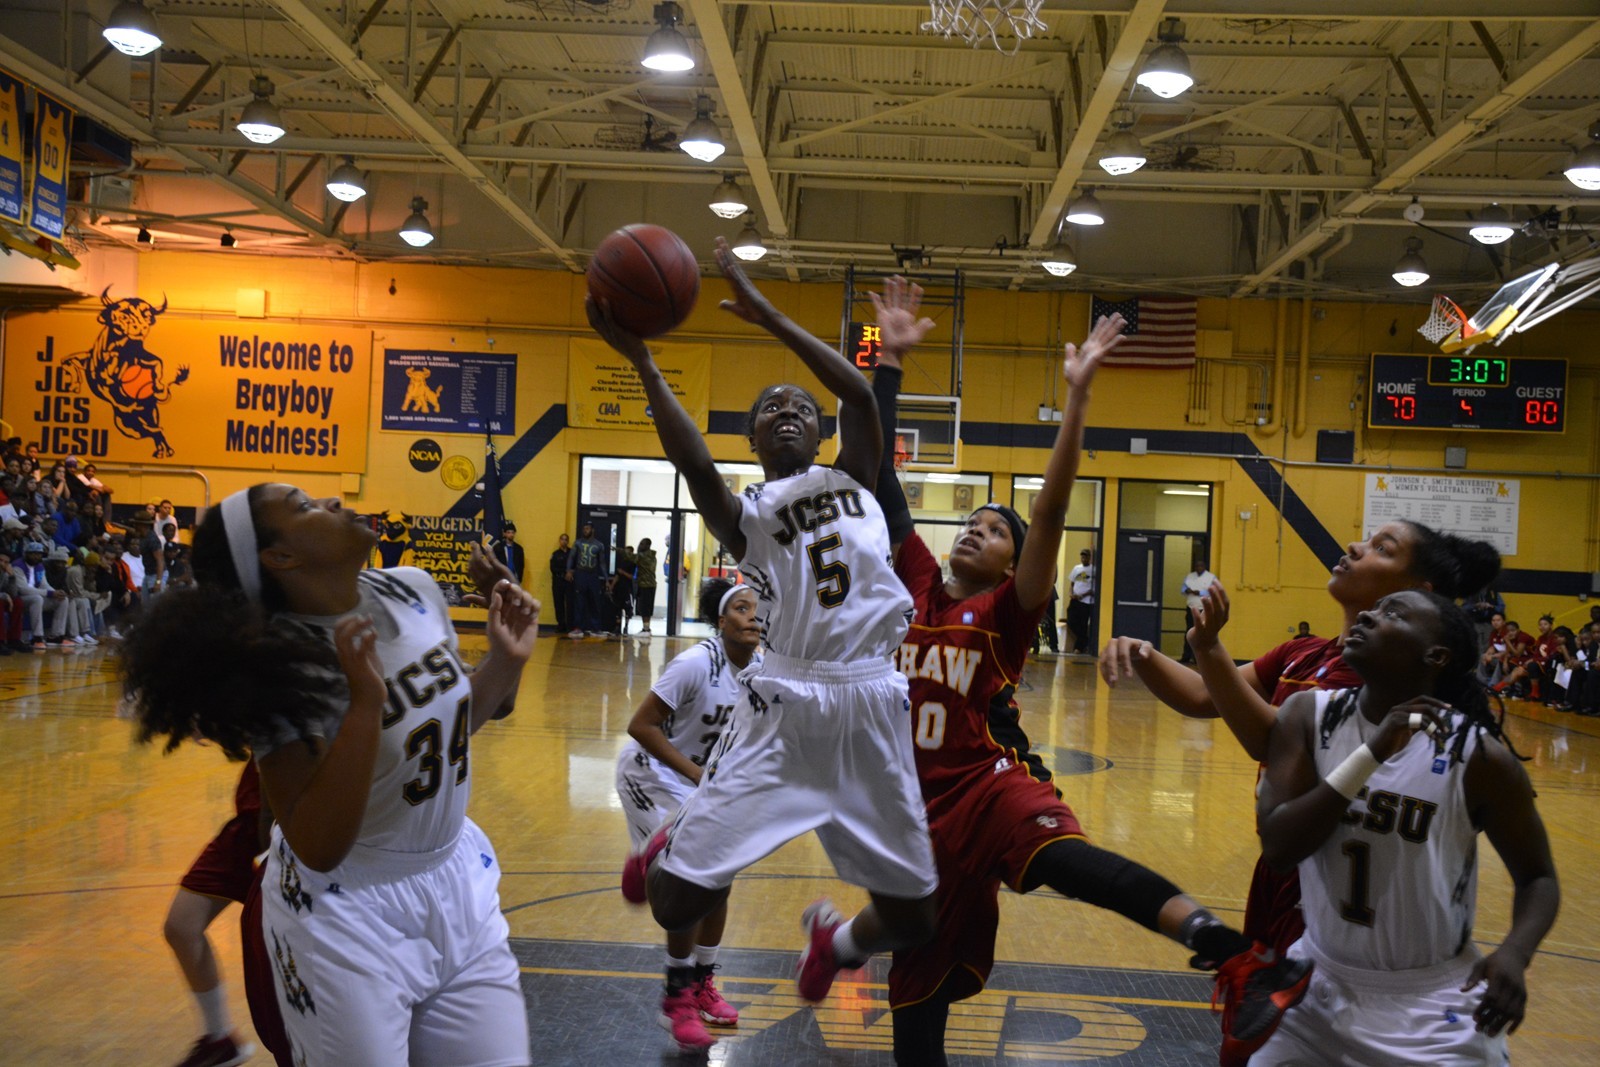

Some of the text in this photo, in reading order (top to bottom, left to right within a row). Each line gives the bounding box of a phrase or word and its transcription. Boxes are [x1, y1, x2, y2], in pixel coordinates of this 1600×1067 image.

[44, 141, 59, 171] 00
[36, 336, 54, 362] J
[219, 335, 354, 374] Welcome to
[35, 366, 72, 393] JC
[1450, 360, 1506, 383] 3:07
[236, 378, 334, 420] Brayboy
[1377, 382, 1416, 395] HOME
[1452, 388, 1486, 398] PERIOD
[1516, 386, 1563, 399] GUEST
[34, 396, 90, 424] JCS
[598, 402, 621, 416] CIAA
[1386, 396, 1415, 420] 70
[1526, 400, 1558, 424] 80
[38, 426, 109, 457] JCSU
[226, 420, 339, 457] Madness!
[410, 450, 440, 462] NCAA
[1391, 476, 1420, 484] JOHNSON
[1456, 480, 1496, 488] UNIVERSITY
[1428, 486, 1468, 494] VOLLEYBALL
[411, 516, 440, 531] JCSU
[442, 517, 472, 532] GETS
[773, 489, 867, 546] JCSU
[415, 540, 453, 550] STAND
[424, 532, 454, 541] YOU
[412, 551, 450, 560] HANCE
[806, 532, 852, 610] 5
[893, 643, 983, 698] HAW
[381, 638, 459, 730] JCS
[702, 704, 736, 726] JC
[402, 692, 471, 807] 34
[1341, 839, 1376, 929] 1
